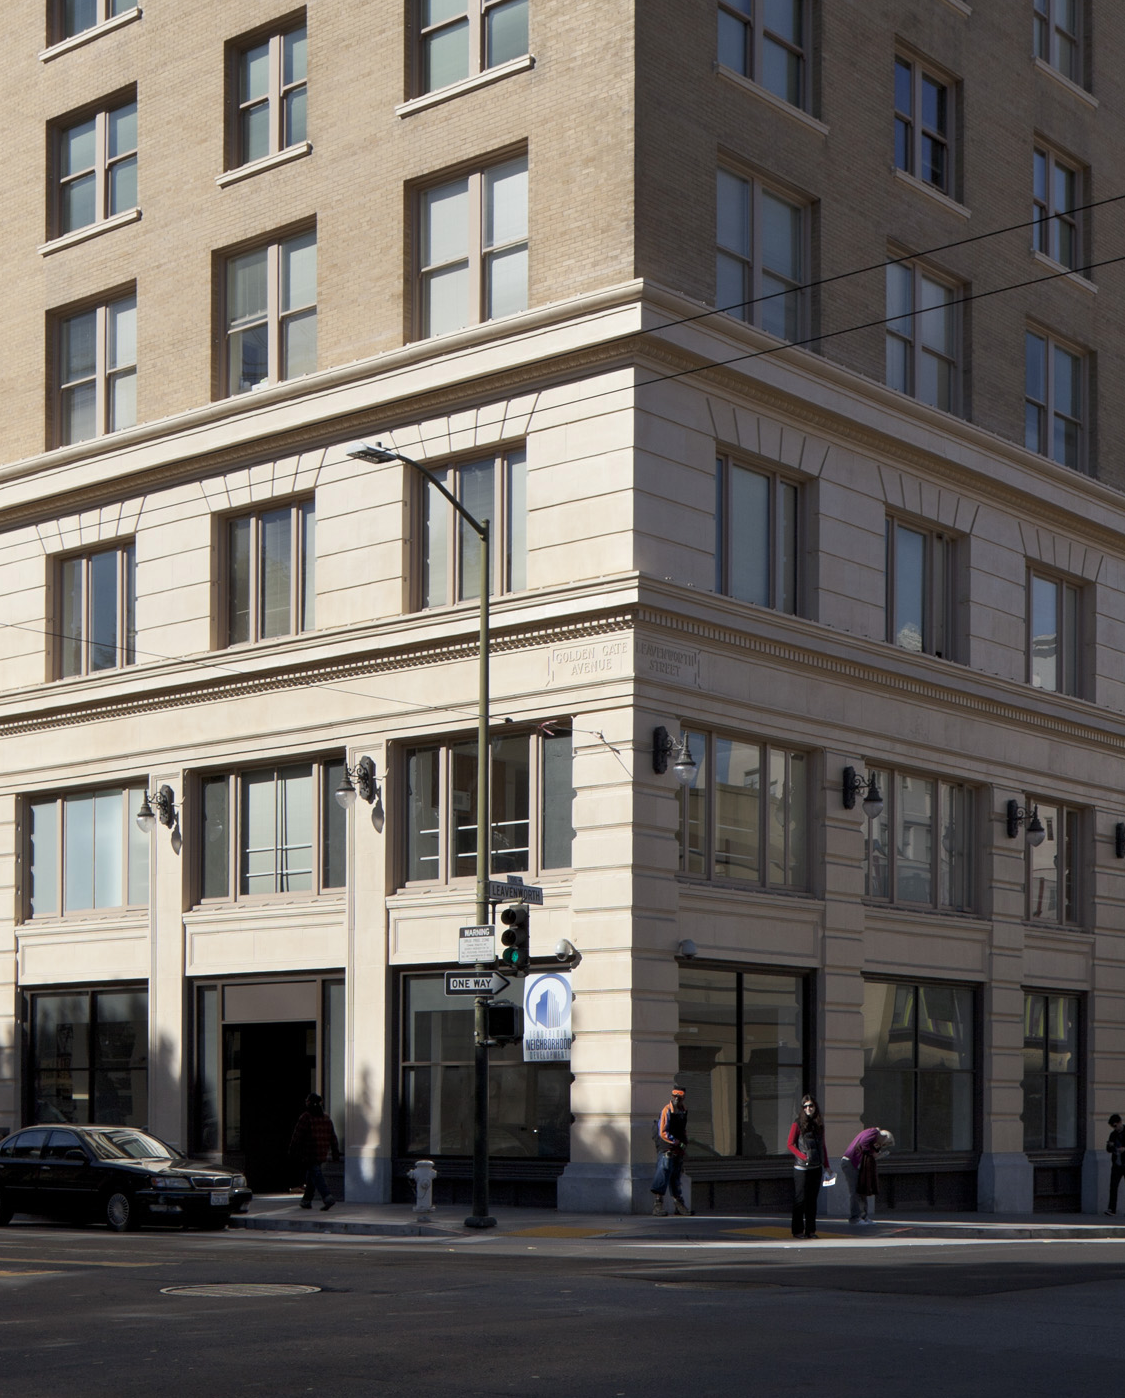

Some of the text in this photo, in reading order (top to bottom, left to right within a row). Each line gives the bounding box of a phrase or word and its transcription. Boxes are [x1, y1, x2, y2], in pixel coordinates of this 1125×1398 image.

[556, 643, 628, 664] GOLDEN GATE
[635, 642, 694, 667] LEAVENWORTH
[571, 659, 612, 676] AVENUE
[649, 659, 681, 677] STREET
[492, 885, 541, 901] LEAVENWORTH
[464, 928, 490, 937] WARNING
[452, 978, 491, 988] ONE WAY
[529, 1029, 567, 1038] TENDERLOIN
[526, 1038, 572, 1050] NEIGHBORHOOD
[530, 1051, 568, 1059] DEVELOPMENT
